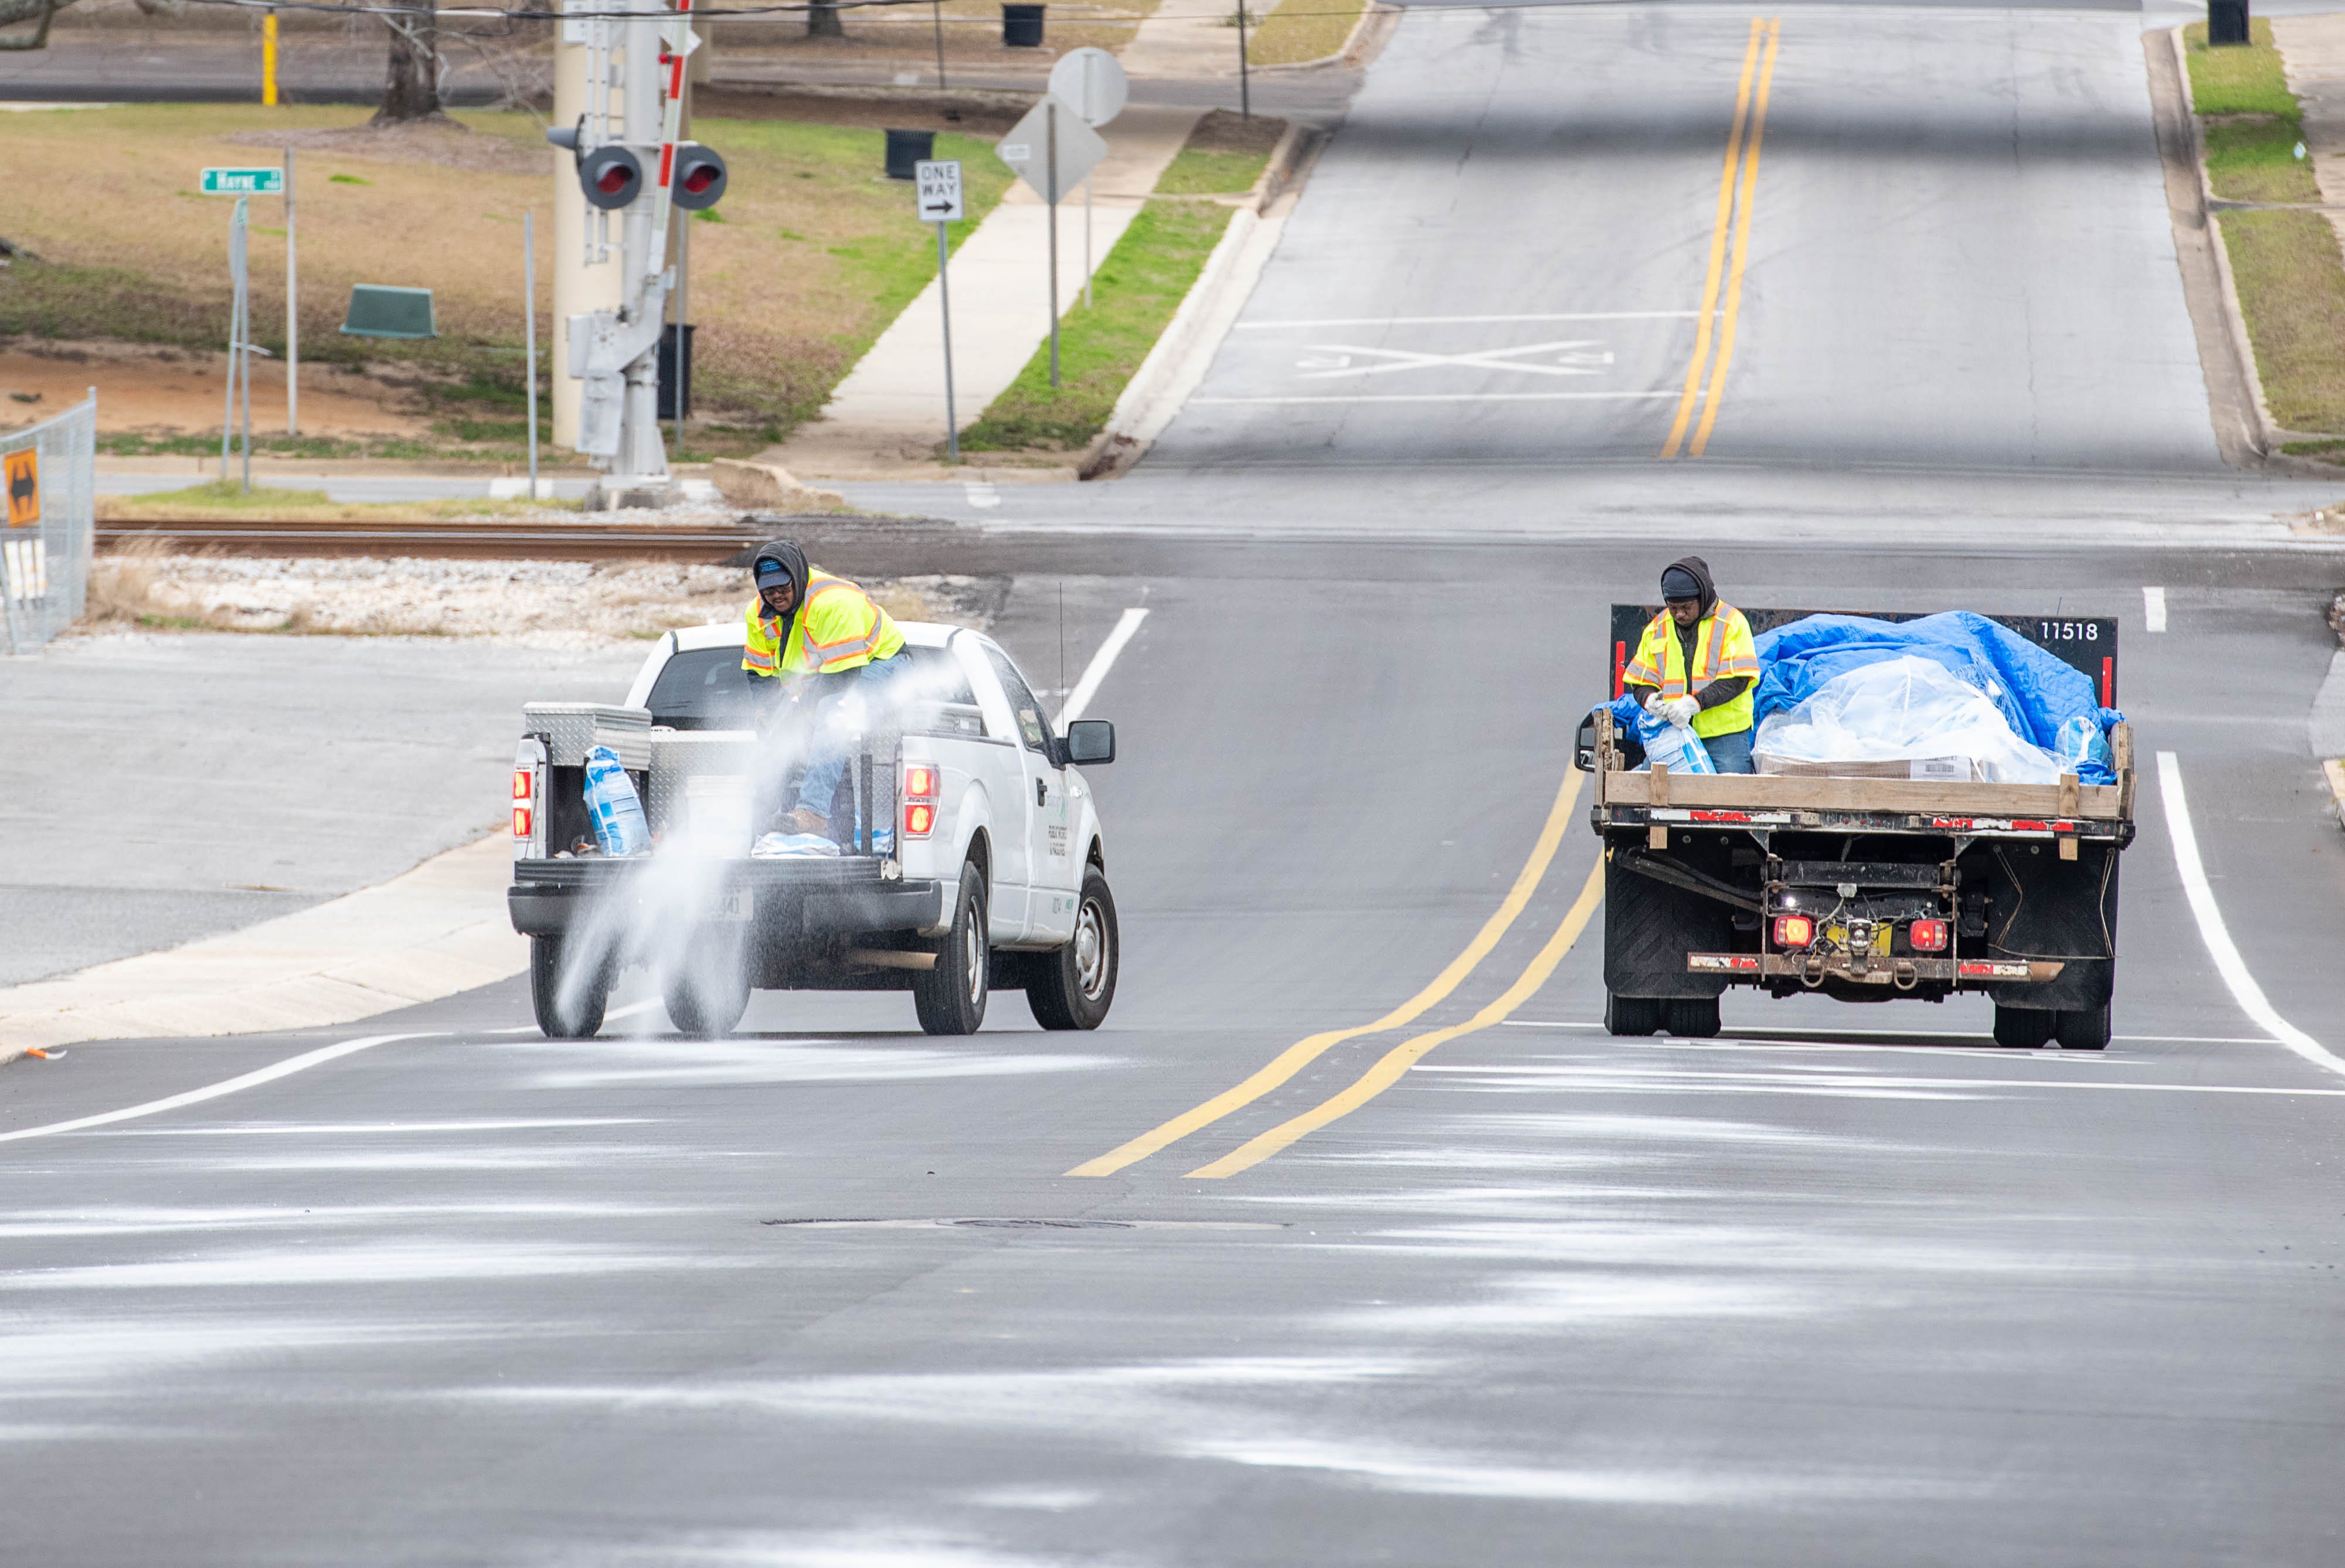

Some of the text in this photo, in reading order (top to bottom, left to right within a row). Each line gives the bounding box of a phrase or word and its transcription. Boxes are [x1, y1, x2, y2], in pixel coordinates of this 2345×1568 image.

[921, 165, 955, 180] ONE
[921, 182, 956, 196] WAY
[2042, 622, 2098, 641] 11518
